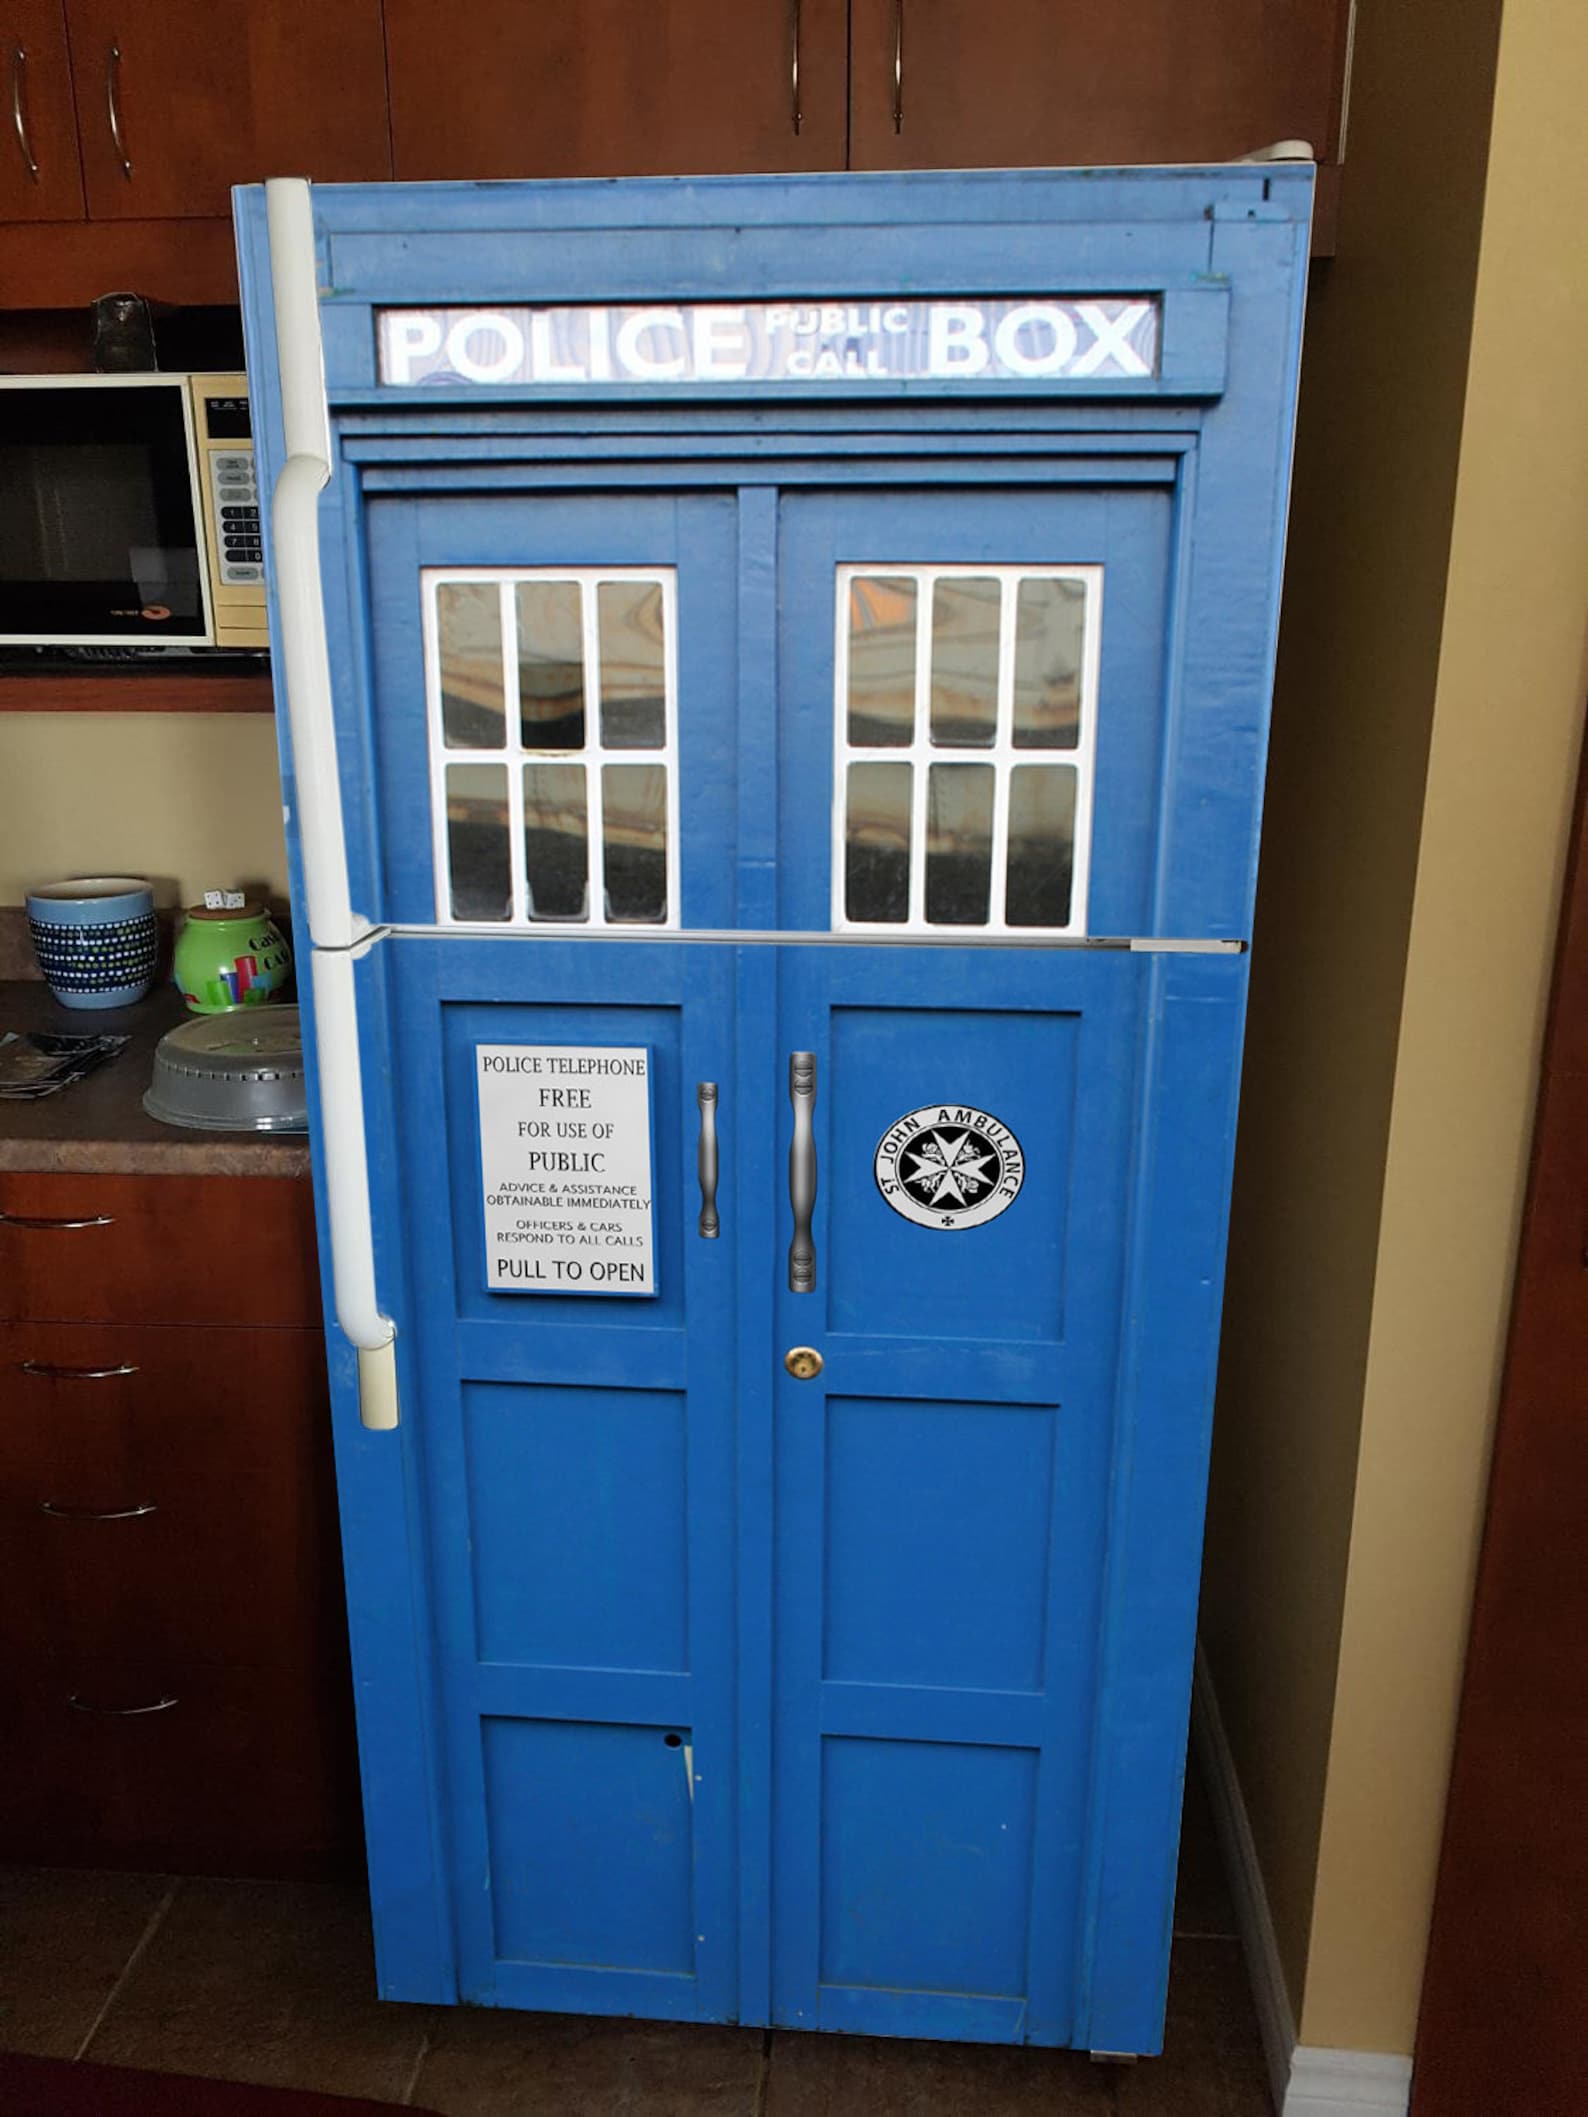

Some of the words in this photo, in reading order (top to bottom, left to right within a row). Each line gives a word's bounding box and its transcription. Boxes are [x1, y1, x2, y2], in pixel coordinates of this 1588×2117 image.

[766, 307, 908, 335] PUBLIC
[391, 309, 747, 384] POLICE
[929, 305, 1152, 378] BOX
[787, 352, 886, 375] CALL
[483, 1056, 542, 1073] POLICE
[547, 1058, 645, 1076] TELEPHONE
[539, 1089, 591, 1108] FREE
[518, 1122, 550, 1137] FOR
[557, 1123, 587, 1139] USE
[593, 1124, 614, 1139] OF
[881, 1117, 920, 1164] JOHN
[529, 1152, 605, 1172] PUBLIC
[938, 1109, 1021, 1199] AMBULANCE
[500, 1183, 545, 1193] ADVICE
[550, 1184, 558, 1193] &
[563, 1184, 637, 1195] ASSISTANCE
[881, 1177, 899, 1194] ST
[487, 1195, 563, 1207] OBTAINABLE
[567, 1197, 651, 1209] IMMEDIATELY
[516, 1220, 573, 1231] OFFICERS
[578, 1221, 586, 1231] &
[591, 1222, 622, 1232] CARS
[497, 1233, 553, 1244] RESPOND
[558, 1234, 575, 1244] TO
[579, 1235, 600, 1245] ALL
[605, 1236, 643, 1247] CALLS
[498, 1259, 546, 1279] PULL
[552, 1261, 582, 1280] TO
[590, 1262, 644, 1281] OPEN
